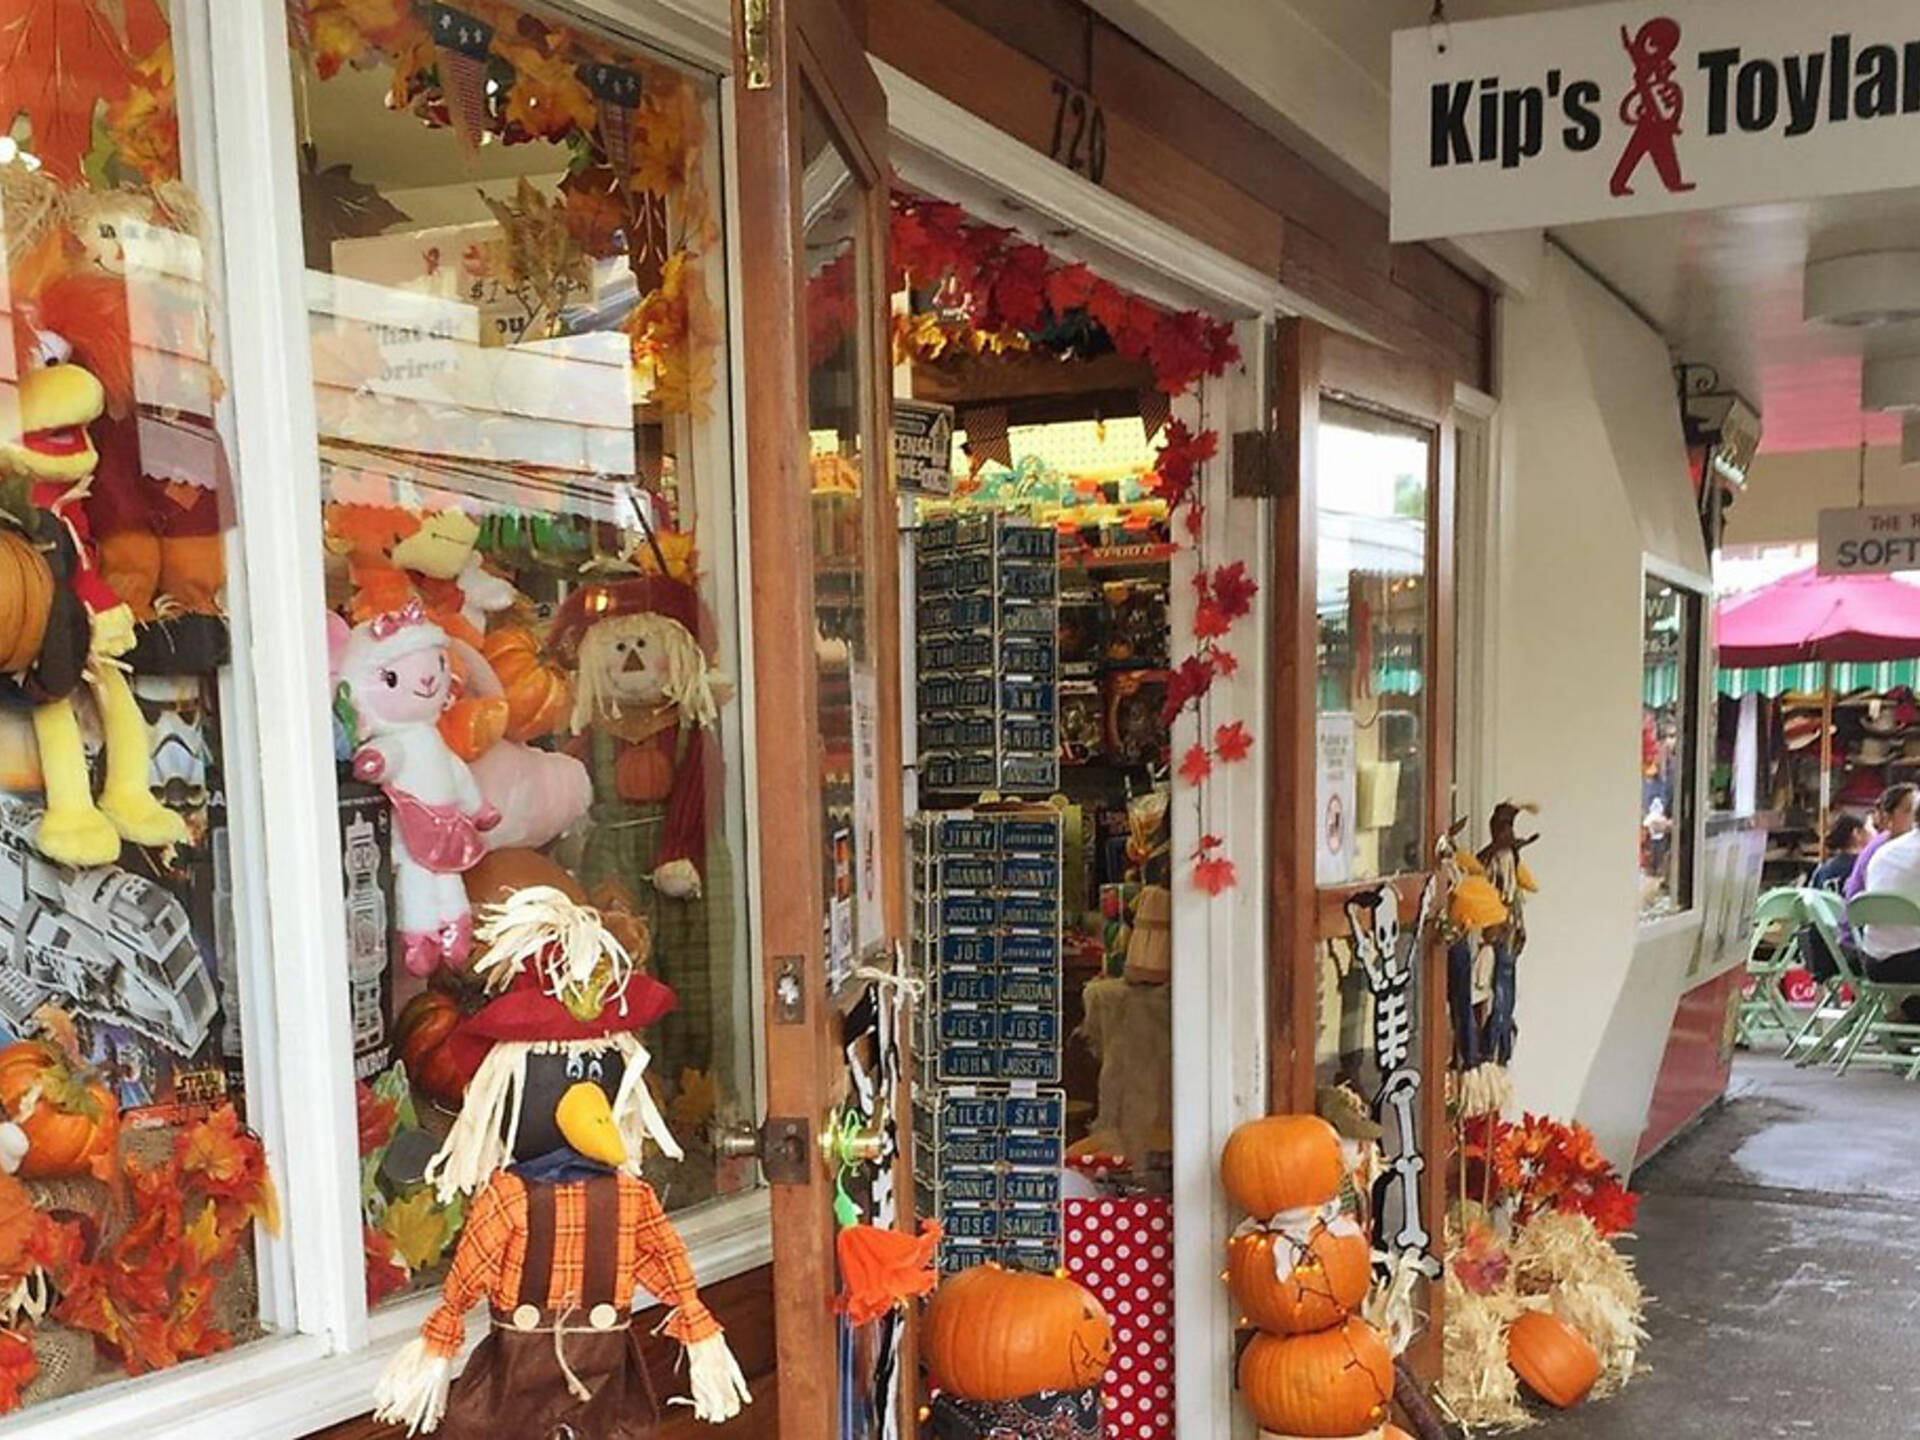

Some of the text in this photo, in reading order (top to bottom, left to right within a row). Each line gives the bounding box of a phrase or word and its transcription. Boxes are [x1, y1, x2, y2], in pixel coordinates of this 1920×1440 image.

[1430, 69, 1602, 168] Kip's
[1051, 79, 1107, 185] 720
[1837, 537, 1920, 568] SOFT
[945, 829, 992, 846] JIMMY
[953, 943, 984, 961] JOE
[948, 981, 1052, 1000] JOEL JORDAN
[947, 1018, 1048, 1038] JOEY JOSE
[948, 1056, 1053, 1076] JOHN JOSEPH
[948, 1106, 1048, 1125] RILEY SAM
[1006, 1180, 1057, 1198] SAMMY
[949, 1216, 1055, 1236] ROSE SAMUEL
